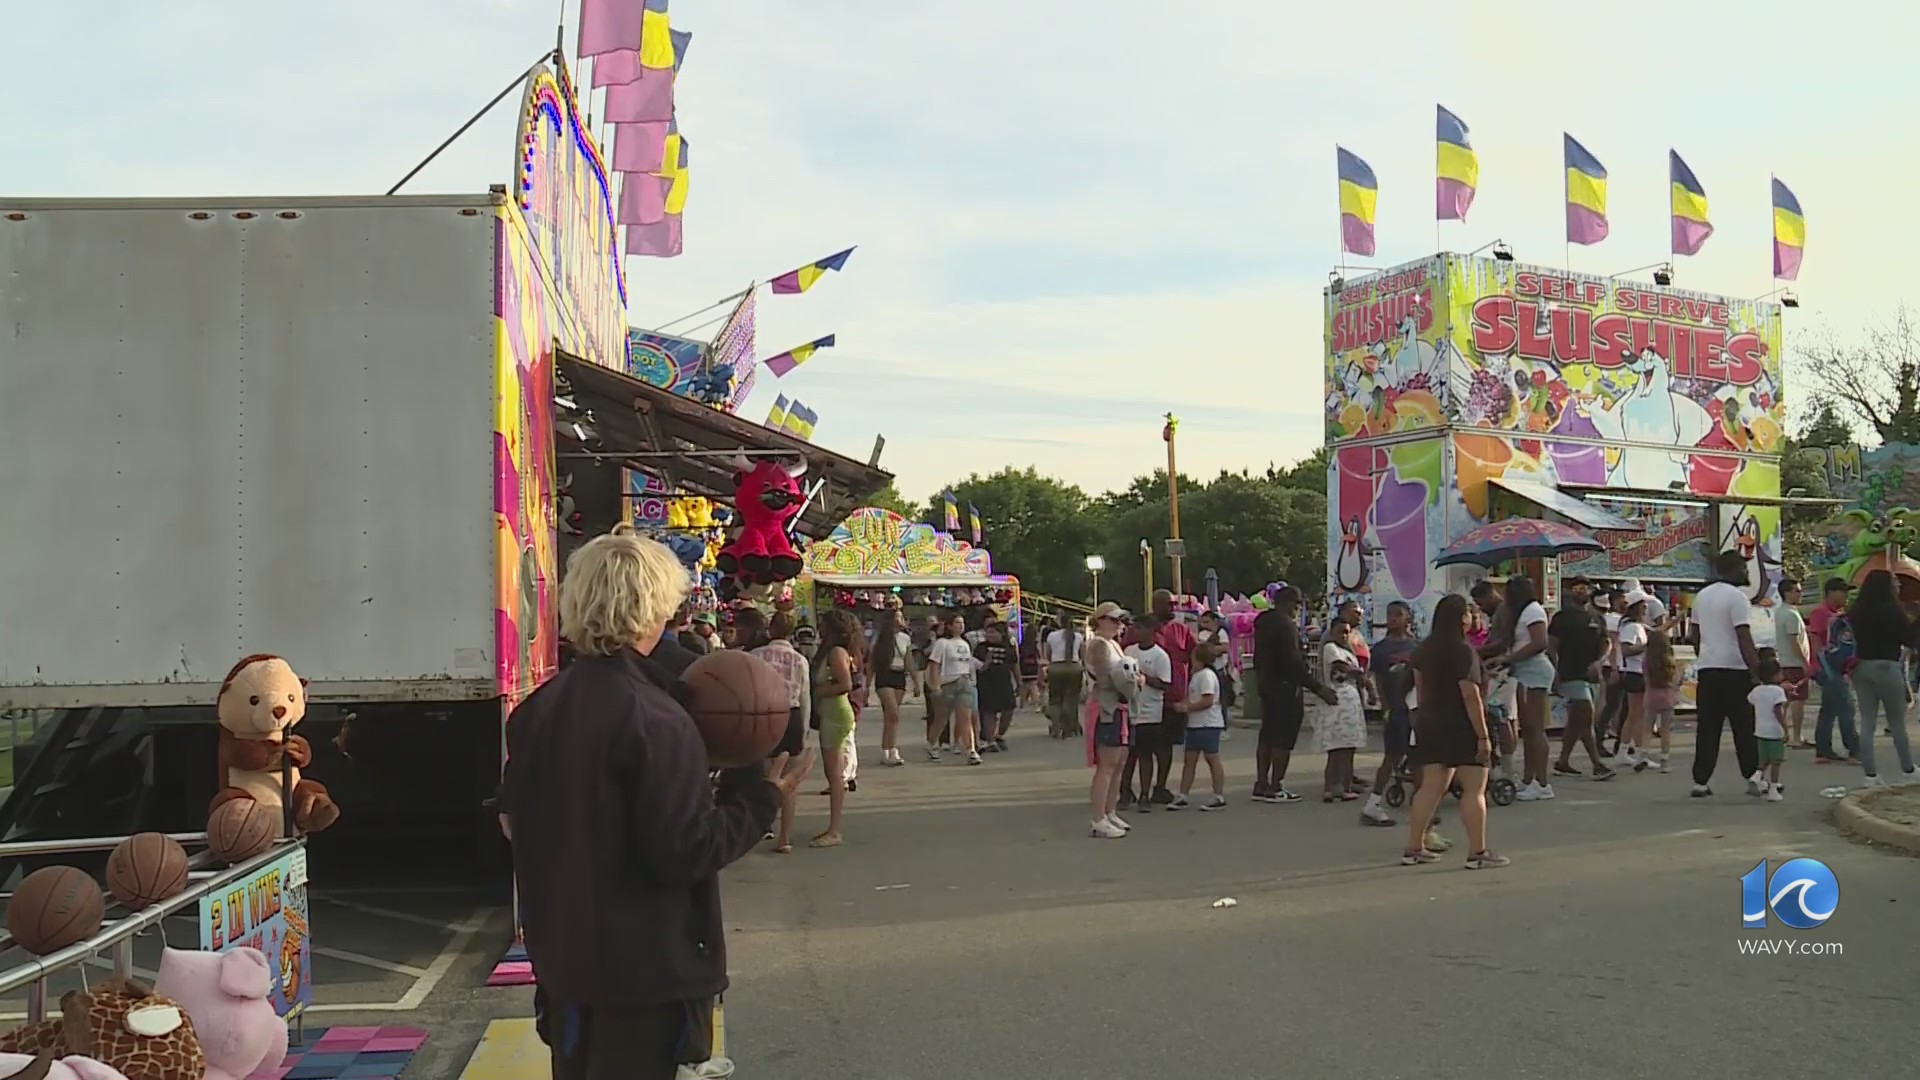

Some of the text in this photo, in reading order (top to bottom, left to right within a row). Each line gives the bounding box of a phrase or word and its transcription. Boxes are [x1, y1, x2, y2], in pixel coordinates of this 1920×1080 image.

[1339, 267, 1427, 305] SELF SERVE
[1515, 272, 1729, 325] SELF SERVE
[1332, 287, 1434, 354] SLUSHIES
[1472, 295, 1763, 386] SLUSHIES
[812, 541, 933, 572] ZONE
[849, 516, 901, 547] FUN
[211, 898, 223, 951] 2
[228, 887, 245, 943] IN
[248, 867, 281, 930] WINS
